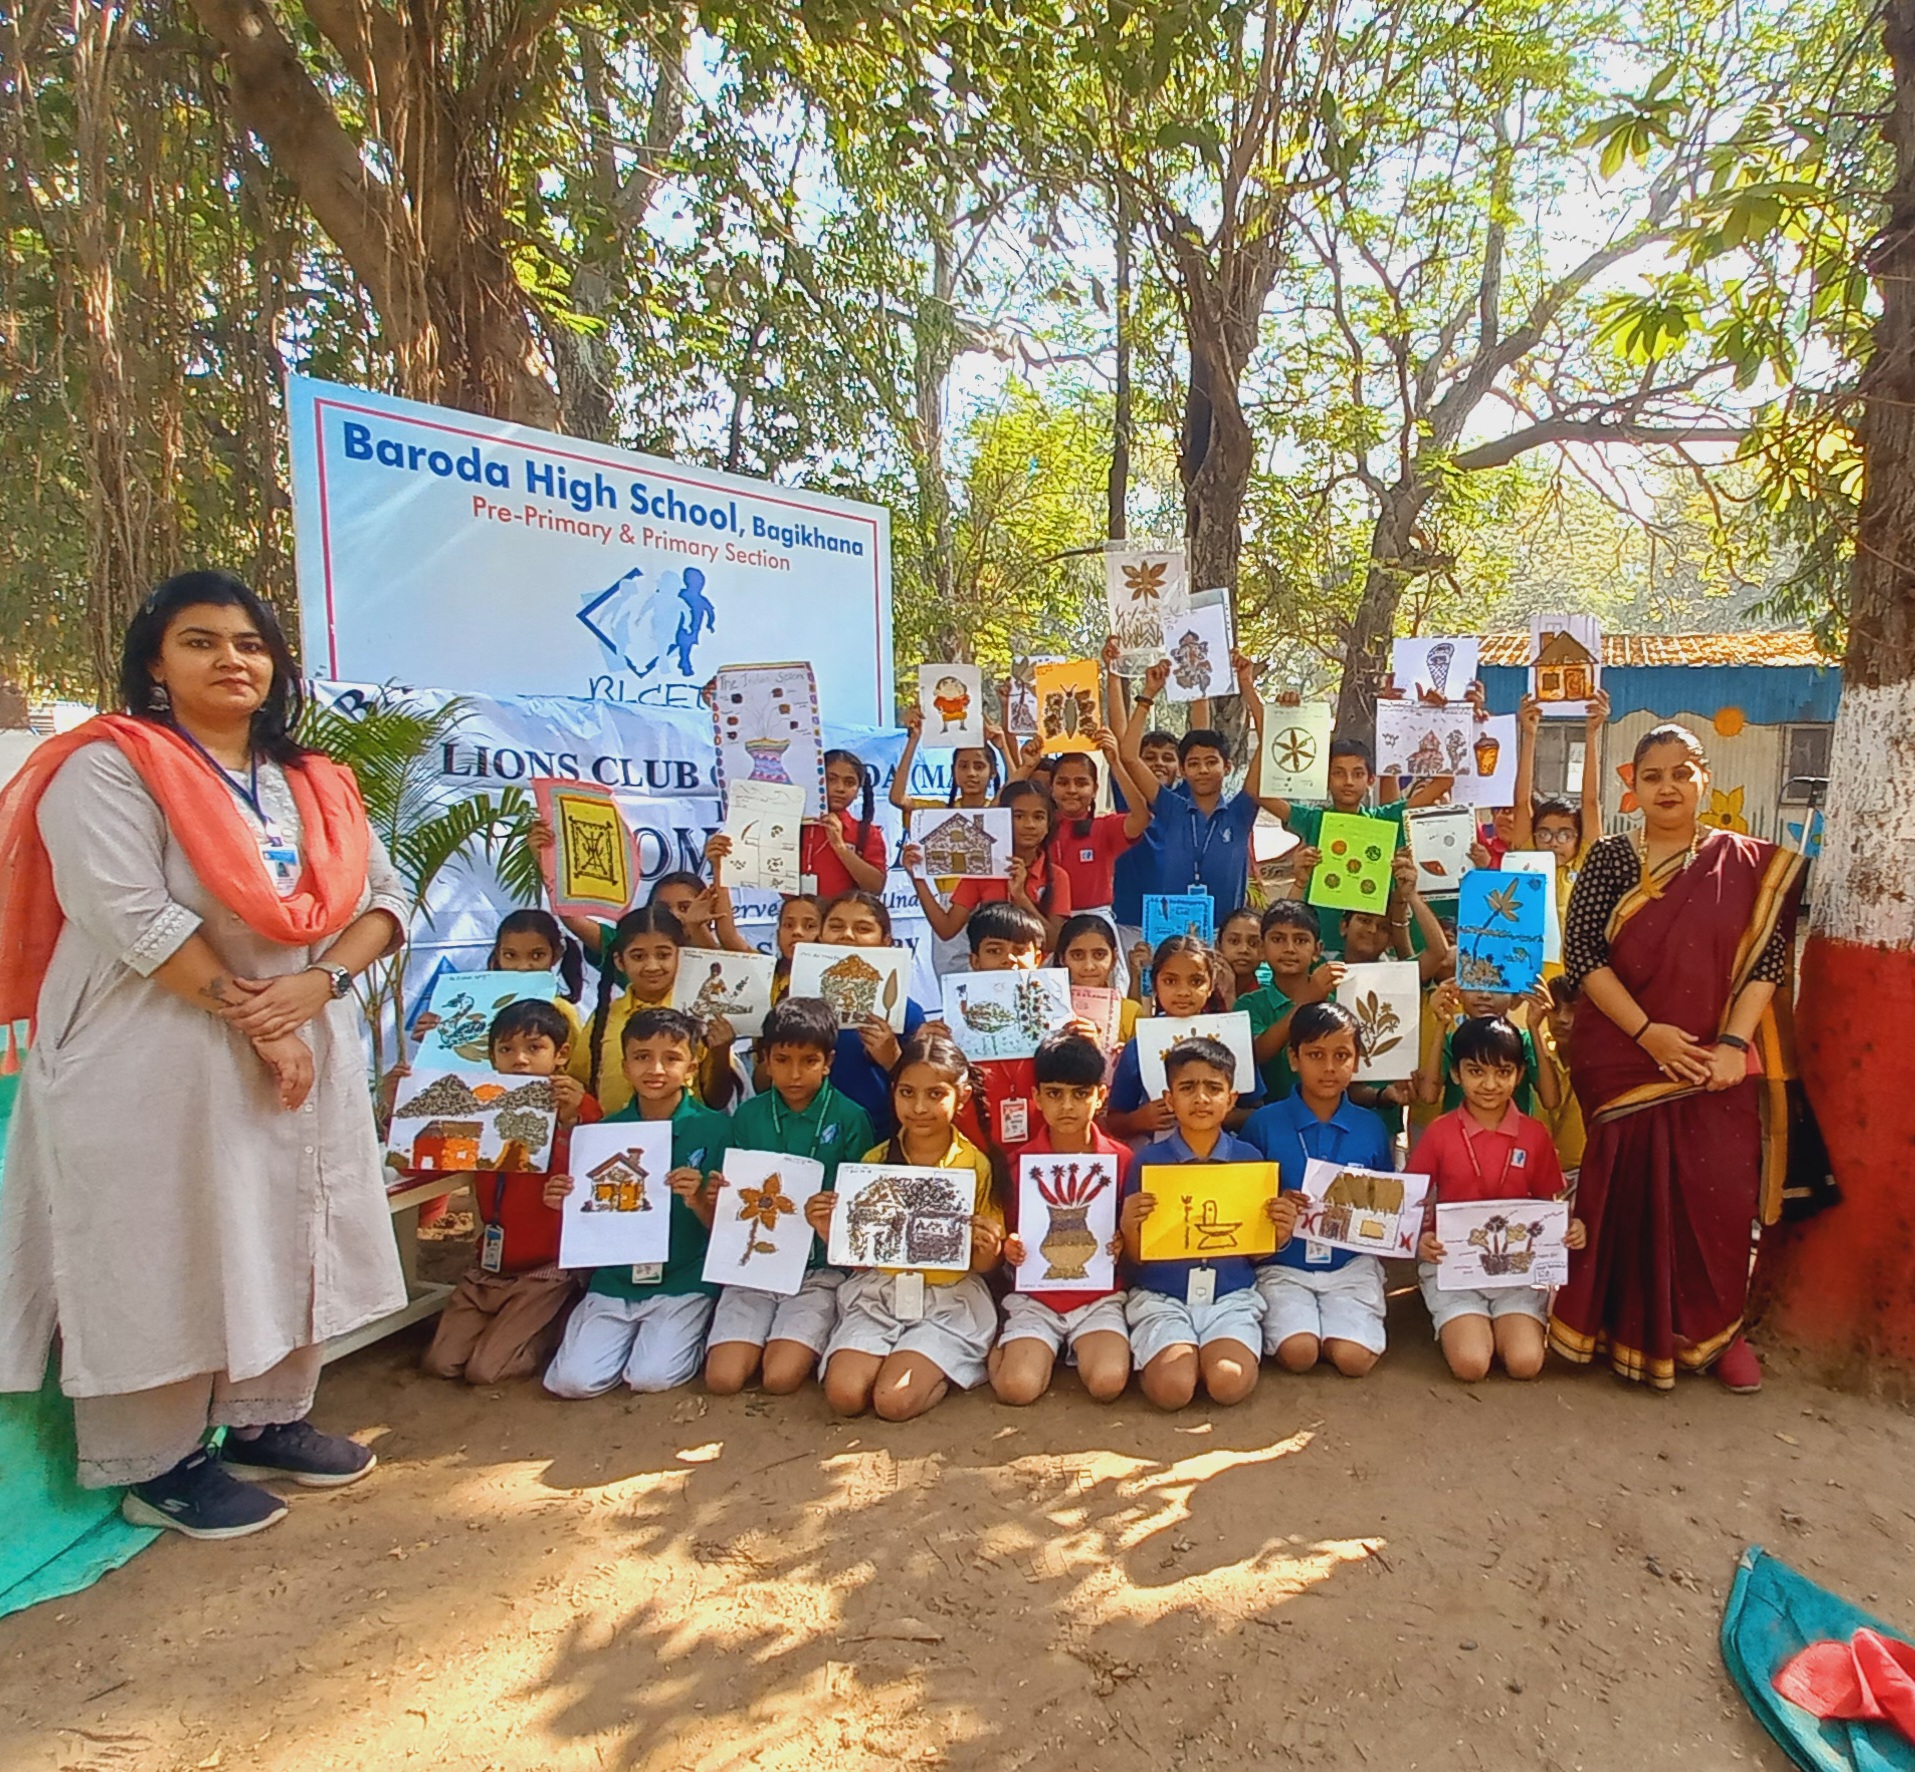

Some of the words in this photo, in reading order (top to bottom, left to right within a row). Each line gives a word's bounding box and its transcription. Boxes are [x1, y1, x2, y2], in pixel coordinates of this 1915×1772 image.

[343, 421, 510, 488] Baroda
[526, 459, 617, 513] High
[630, 482, 745, 538] School,
[752, 515, 864, 556] Bagikhana
[472, 495, 612, 545] Pre-Primary
[619, 523, 635, 545] &
[643, 526, 719, 563] Primary
[725, 542, 790, 571] Section
[440, 742, 580, 781] LIONS
[591, 756, 700, 790] CLUB
